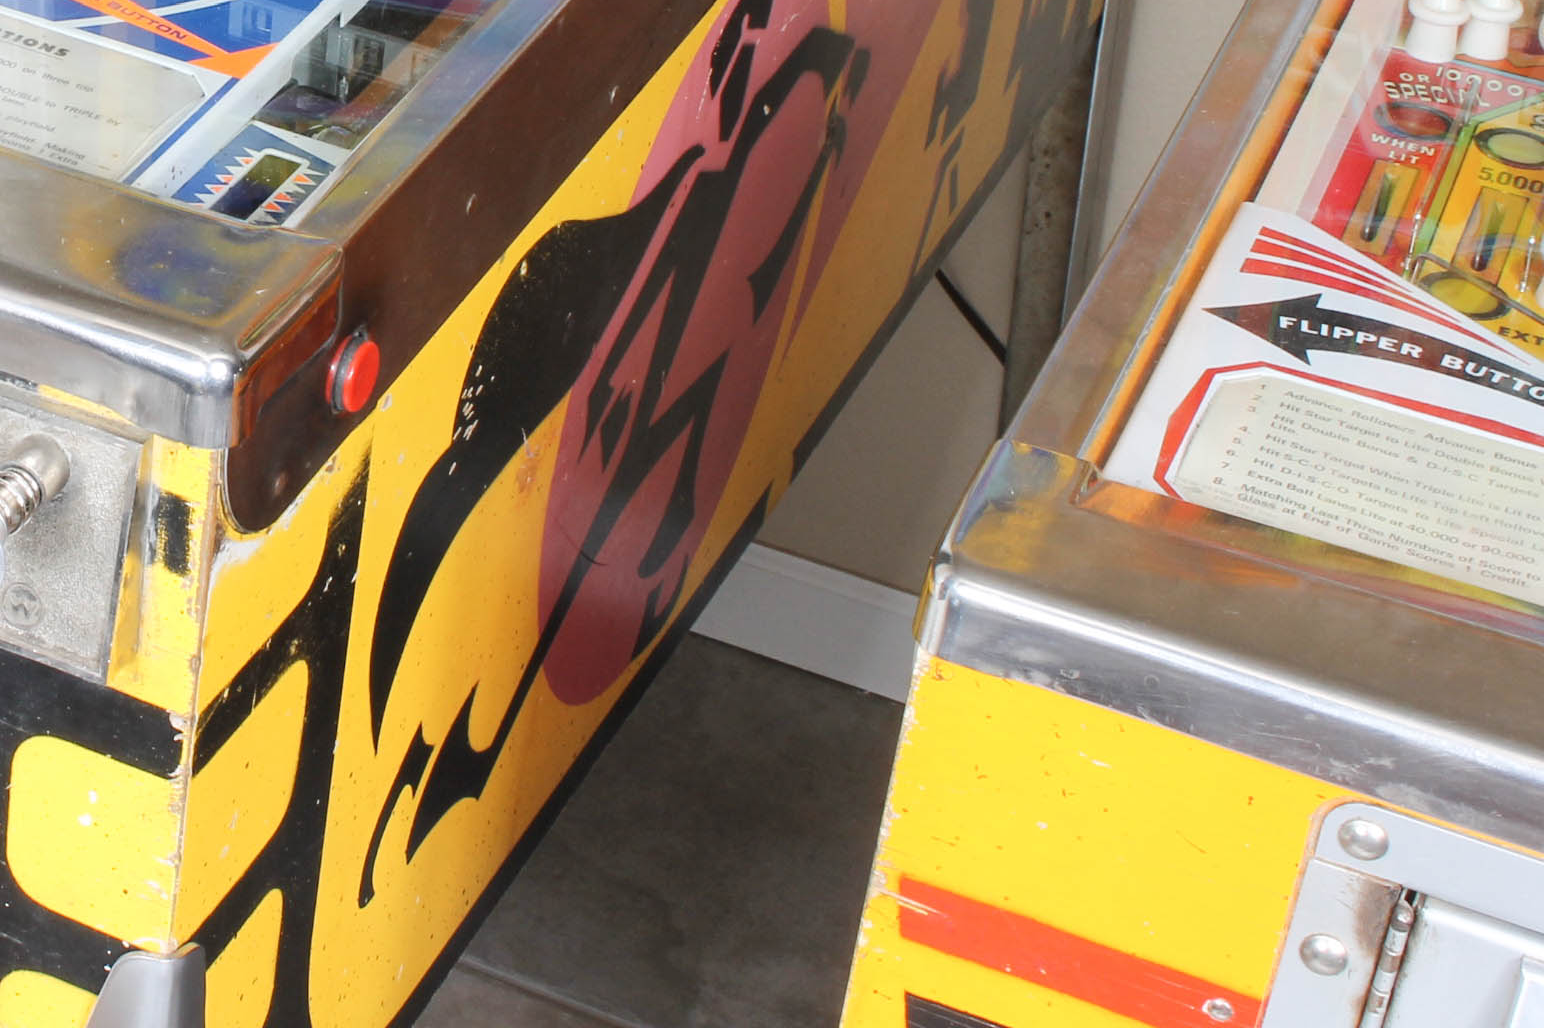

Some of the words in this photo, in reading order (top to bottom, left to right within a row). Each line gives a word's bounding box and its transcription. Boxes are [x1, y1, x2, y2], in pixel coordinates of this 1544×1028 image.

[106, 0, 188, 42] BUTTON
[1400, 72, 1430, 84] OR
[1371, 132, 1436, 156] WHEN
[1389, 150, 1421, 164] LIT
[1279, 316, 1424, 359] FLIPPER
[1440, 353, 1544, 400] BUTTO
[1273, 413, 1295, 425] Hit
[1301, 423, 1350, 443] Double
[1356, 440, 1400, 458] Bonus
[1407, 456, 1418, 464] &
[1488, 478, 1540, 498] Targets
[1280, 402, 1300, 413] Hit
[1305, 410, 1333, 422] Star
[1338, 420, 1382, 438] Target
[1385, 436, 1399, 444] to
[1404, 439, 1430, 453] Lite
[1434, 449, 1485, 469] Double
[1489, 465, 1535, 483] Bonus
[1284, 391, 1343, 413] Advance
[1351, 410, 1417, 434] Rollovers
[1424, 433, 1485, 455] Advance
[1494, 452, 1537, 469] Bonus
[1247, 470, 1282, 486] Extra
[1286, 483, 1313, 496] Ball
[1317, 493, 1357, 511] Lanes
[1360, 508, 1387, 522] Lite
[1253, 458, 1274, 469] Hit
[1356, 492, 1408, 514] Targets
[1415, 512, 1429, 520] to
[1470, 527, 1524, 547] Special
[1259, 446, 1280, 457] Hit
[1329, 468, 1382, 490] Targets
[1385, 488, 1398, 496] to
[1402, 491, 1428, 505] Lite
[1434, 501, 1459, 515] Top
[1265, 434, 1287, 445] Hit
[1290, 442, 1318, 455] Star
[1322, 452, 1365, 471] Target
[1369, 467, 1409, 484] When
[1415, 481, 1455, 498] Triple
[1458, 494, 1485, 507] Lite
[1505, 507, 1523, 517] Lit
[1237, 493, 1277, 509] Glass
[1282, 508, 1296, 516] at
[1303, 512, 1330, 526] End
[1336, 525, 1351, 534] of
[1357, 532, 1400, 552] Game
[1406, 548, 1455, 568] Scores
[1240, 484, 1305, 510] Matching
[1311, 507, 1339, 521] Last
[1344, 517, 1384, 536] Three
[1389, 534, 1454, 559] Numbers
[1458, 555, 1473, 563] of
[1478, 560, 1521, 576] Score
[1526, 573, 1541, 581] to
